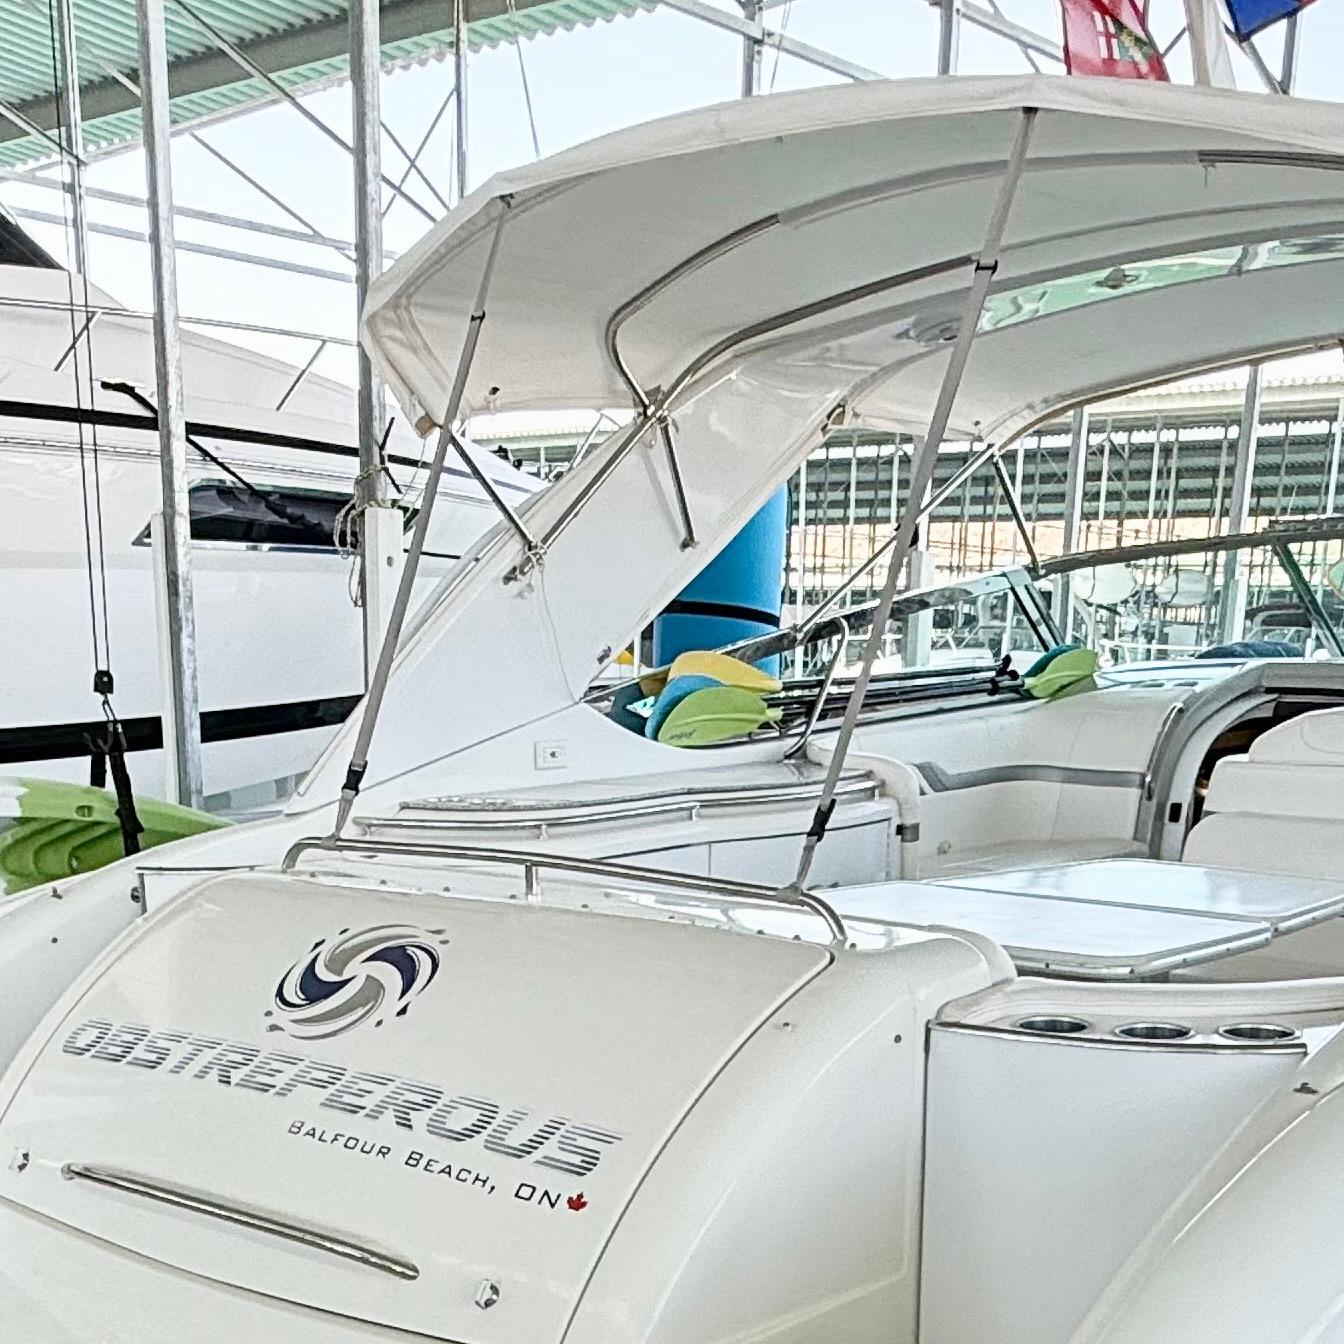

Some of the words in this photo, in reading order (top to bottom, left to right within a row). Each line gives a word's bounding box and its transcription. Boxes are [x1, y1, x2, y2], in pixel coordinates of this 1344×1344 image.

[61, 1016, 625, 1178] OBSTREPEROUS
[287, 1118, 393, 1159] BALFOUR
[513, 1181, 562, 1211] ON
